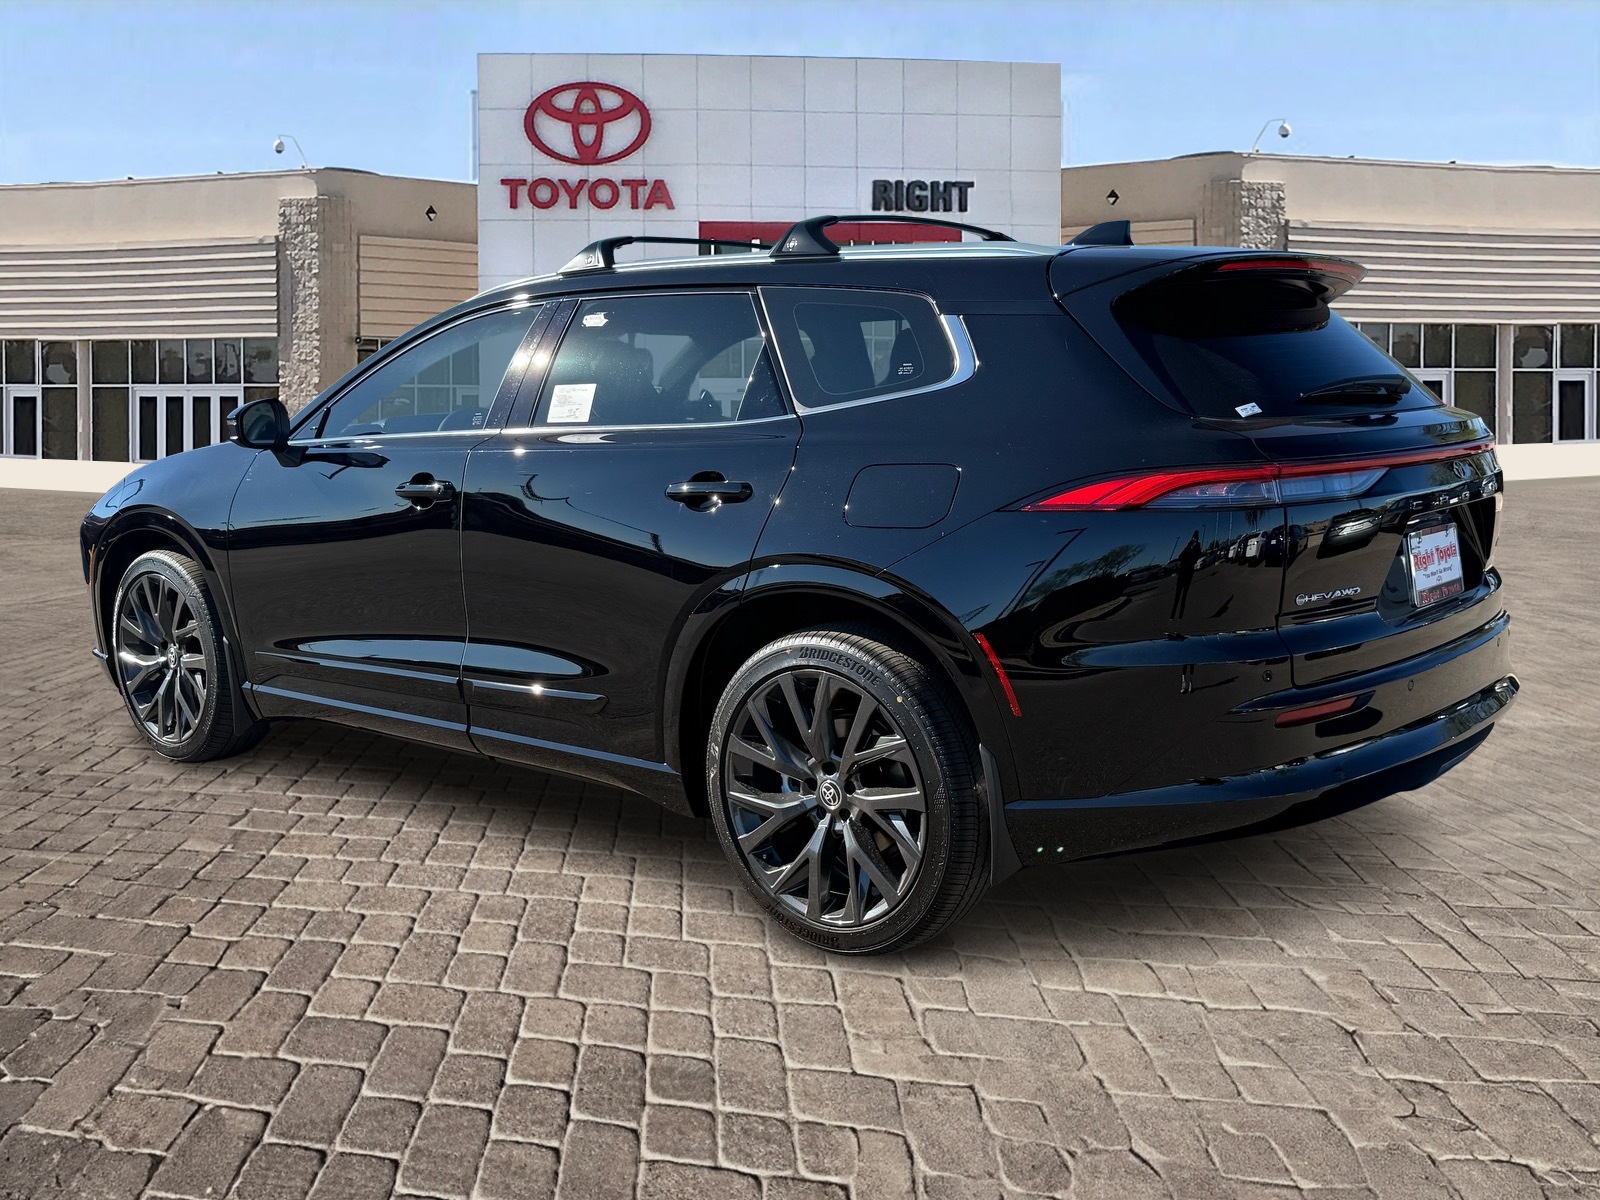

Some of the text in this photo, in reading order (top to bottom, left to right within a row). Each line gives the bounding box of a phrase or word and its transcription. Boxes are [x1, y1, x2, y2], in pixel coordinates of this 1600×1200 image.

[500, 178, 675, 210] TOYOTA
[871, 179, 975, 213] RIGHT
[1413, 542, 1457, 571] Right Toyota
[1421, 583, 1460, 604] Right Toyota
[798, 646, 882, 687] BRIDGESTONE
[763, 902, 840, 947] BRIDGESTONE
